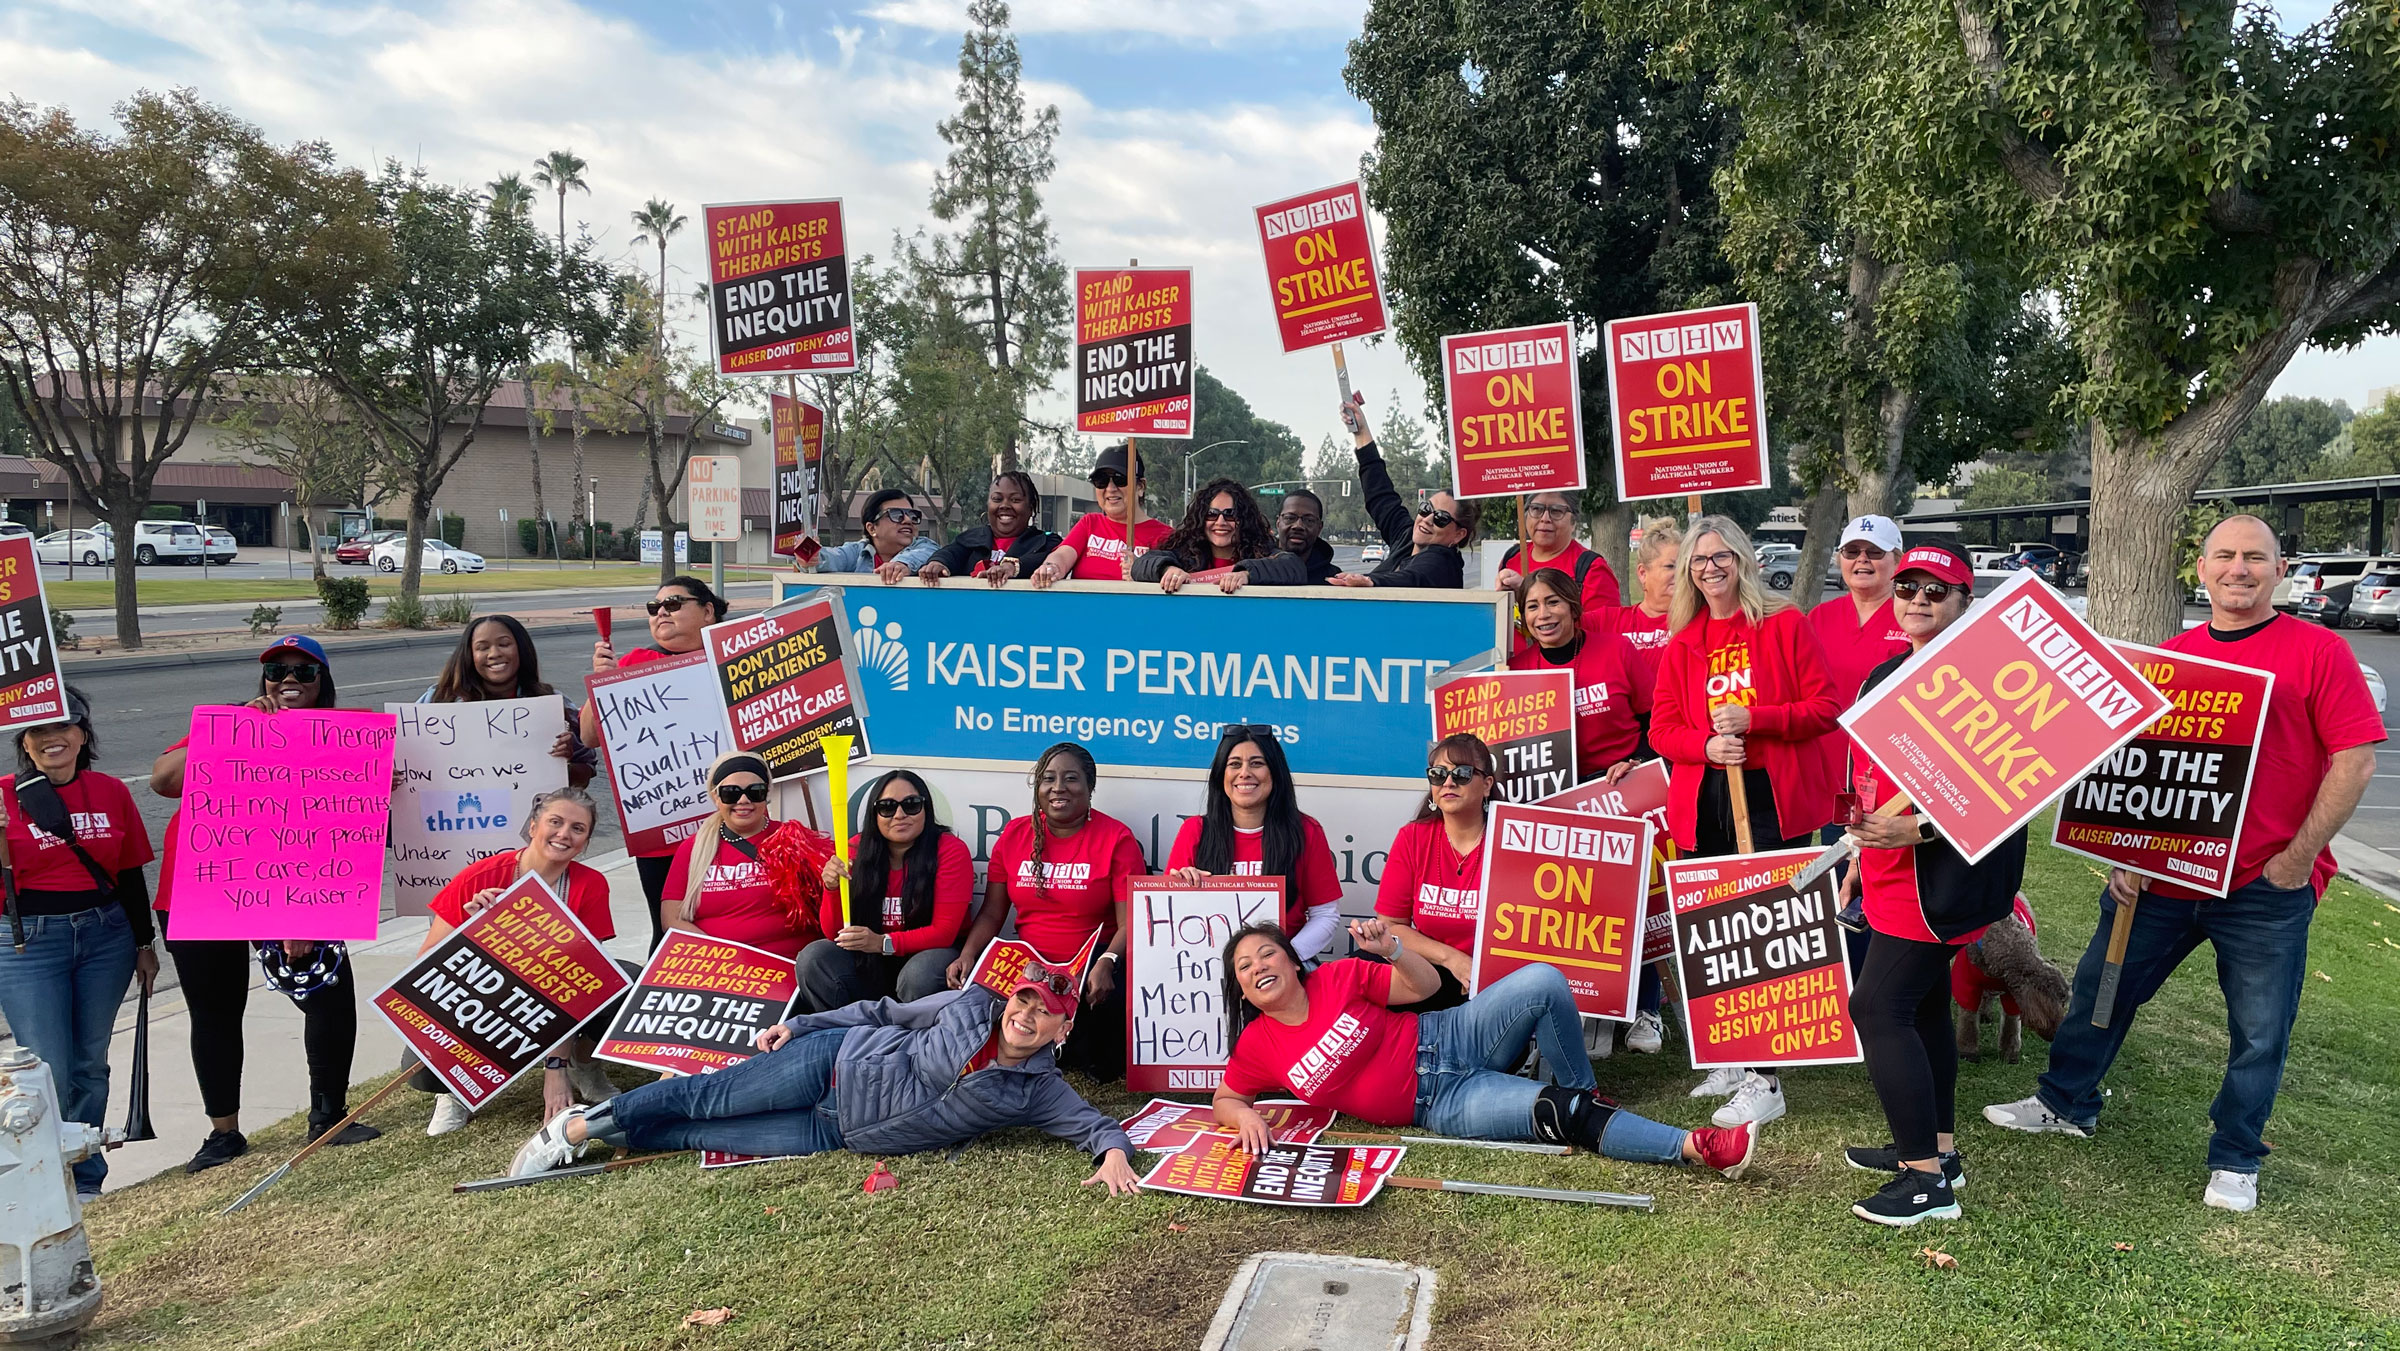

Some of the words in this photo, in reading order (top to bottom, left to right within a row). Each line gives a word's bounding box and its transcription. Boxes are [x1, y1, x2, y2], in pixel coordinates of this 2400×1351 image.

[716, 209, 775, 238] STAND
[1266, 195, 1354, 237] NUHW
[718, 233, 762, 258] WITH
[767, 217, 828, 247] KAISER
[1294, 229, 1338, 265] ON
[719, 240, 822, 278] THERAPISTS
[725, 279, 775, 313] END
[781, 266, 829, 299] THE
[1084, 275, 1133, 301] STAND
[1277, 258, 1369, 306] STRIKE
[726, 292, 843, 342] INEQUITY
[1084, 299, 1121, 321] WITH
[1125, 286, 1179, 312] KAISER
[1084, 307, 1172, 340] THERAPISTS
[1623, 322, 1741, 360] NUHW
[730, 331, 849, 369] KAISERDONTDENY.ORG
[811, 352, 849, 364] NUHW
[1087, 343, 1128, 374] END
[1134, 334, 1175, 364] THE
[1458, 340, 1560, 371] NUHW
[1085, 361, 1186, 402] INEQUITY
[1486, 373, 1535, 408] ON
[1656, 359, 1712, 399] ON
[1085, 399, 1188, 427] KAISERDONTDENY.ORG
[1154, 419, 1187, 429] NUHW
[1461, 407, 1567, 448] STRIKE
[1628, 397, 1749, 444] STRIKE
[692, 460, 710, 479] NO
[780, 471, 801, 496] END
[1482, 472, 1522, 481] HEALTHCARE
[1524, 469, 1555, 478] WORKERS
[1486, 467, 1516, 475] NATIONAL
[1518, 464, 1540, 472] UNION
[1651, 470, 1698, 481] HEALTHCARE
[1699, 466, 1734, 476] WORKERS
[1655, 465, 1691, 474] NATIONAL
[1693, 462, 1718, 470] UNION
[1680, 480, 1712, 488] nuhw.org
[692, 487, 737, 503] PARKING
[705, 506, 724, 517] ANY
[704, 520, 726, 531] TIME
[641, 539, 686, 549] STOCLE
[1908, 551, 1951, 567] NUHW
[721, 619, 785, 658] KAISER,
[727, 646, 775, 682] DON'T
[778, 626, 819, 659] DENY
[591, 674, 622, 686] NATIONAL
[623, 668, 645, 679] UNION
[653, 657, 692, 671] HEALTHCARE
[731, 676, 754, 701] MY
[757, 645, 827, 689] PATIENTS
[927, 641, 1086, 691] KAISER
[2003, 597, 2140, 726] NUHW
[10, 702, 56, 717] NUHW
[737, 685, 801, 726] MENTAL
[1444, 681, 1501, 710] STAND
[1445, 699, 1488, 730] WITH
[1493, 690, 1556, 719] KAISER
[1993, 660, 2070, 732] ON
[2160, 689, 2243, 714] KAISER
[400, 706, 456, 745] Hey
[485, 706, 530, 738] KP,
[741, 706, 802, 744] HEALTH
[803, 684, 846, 716] CARE
[955, 705, 994, 731] No
[1003, 707, 1164, 744] Emergency
[1173, 713, 1300, 744] Seres
[1916, 664, 2057, 801] STRIKE
[225, 759, 379, 788] Thera-pissed!
[393, 758, 432, 783] How
[448, 766, 485, 779] can
[492, 762, 527, 776] we
[619, 730, 718, 790] Quality
[1504, 741, 1553, 774] THE
[1888, 733, 1934, 781] HEALTHCARE
[1933, 780, 1968, 817] WORKERS
[1900, 733, 1935, 771] NATIONAL
[1935, 769, 1960, 796] UNION
[2158, 749, 2223, 784] THE
[189, 791, 243, 819] Put
[249, 796, 289, 823] my
[302, 794, 391, 820] patients
[621, 776, 690, 814] MENTAL
[660, 791, 708, 816] CARE
[1576, 790, 1628, 816] FAIR
[2074, 780, 2233, 823] INEQUITY
[190, 823, 258, 852] Over
[270, 826, 324, 851] your
[329, 823, 386, 853] profit!
[393, 843, 451, 862] Under
[1504, 822, 1634, 862] NUHW
[2068, 827, 2227, 857] KAISERDONTDENY.ORG
[395, 873, 451, 888] Workin
[1533, 862, 1594, 905] ON
[1676, 869, 1719, 883] NUHW
[2167, 857, 2218, 882] NUHW
[224, 887, 270, 911] you
[1419, 908, 1461, 919] HEALTHCARE
[1424, 903, 1457, 913] NATIONAL
[512, 896, 576, 944] STAND
[1144, 893, 1266, 949] Honk
[1492, 902, 1625, 956] STRIKE
[1688, 890, 1824, 954] INEQUITY
[473, 923, 578, 1004] THERAPISTS
[493, 909, 544, 951] WITH
[539, 945, 604, 995] KAISER
[669, 942, 738, 960] STAND
[1765, 927, 1828, 970] END
[652, 970, 771, 996] THERAPISTS
[661, 956, 715, 973] WITH
[715, 962, 788, 983] KAISER
[1170, 950, 1223, 983] for
[1704, 947, 1759, 986] THE
[443, 946, 505, 995] END
[499, 986, 557, 1034] THE
[640, 991, 702, 1018] END
[709, 997, 766, 1023] THE
[1140, 978, 1228, 1018] Ment
[1714, 969, 1838, 1018] THERAPISTS
[412, 967, 541, 1060] INEQUITY
[1708, 1013, 1778, 1045] KAISER
[1784, 995, 1840, 1028] WITH
[386, 997, 506, 1084] KAISERDONTDENY.ORG
[624, 1013, 767, 1047] INEQUITY
[1134, 1016, 1230, 1065] Heal
[1771, 1020, 1843, 1055] STAND
[1289, 1013, 1358, 1088] NUHW
[1304, 1059, 1342, 1098] HEALTHCARE
[1343, 1026, 1370, 1058] WORKERS
[449, 1064, 484, 1098] NUHW
[1167, 1154, 1197, 1186] STAND
[1263, 1149, 1299, 1166] THE
[1290, 1148, 1335, 1200] INEQUITY
[1253, 1165, 1290, 1196] END
